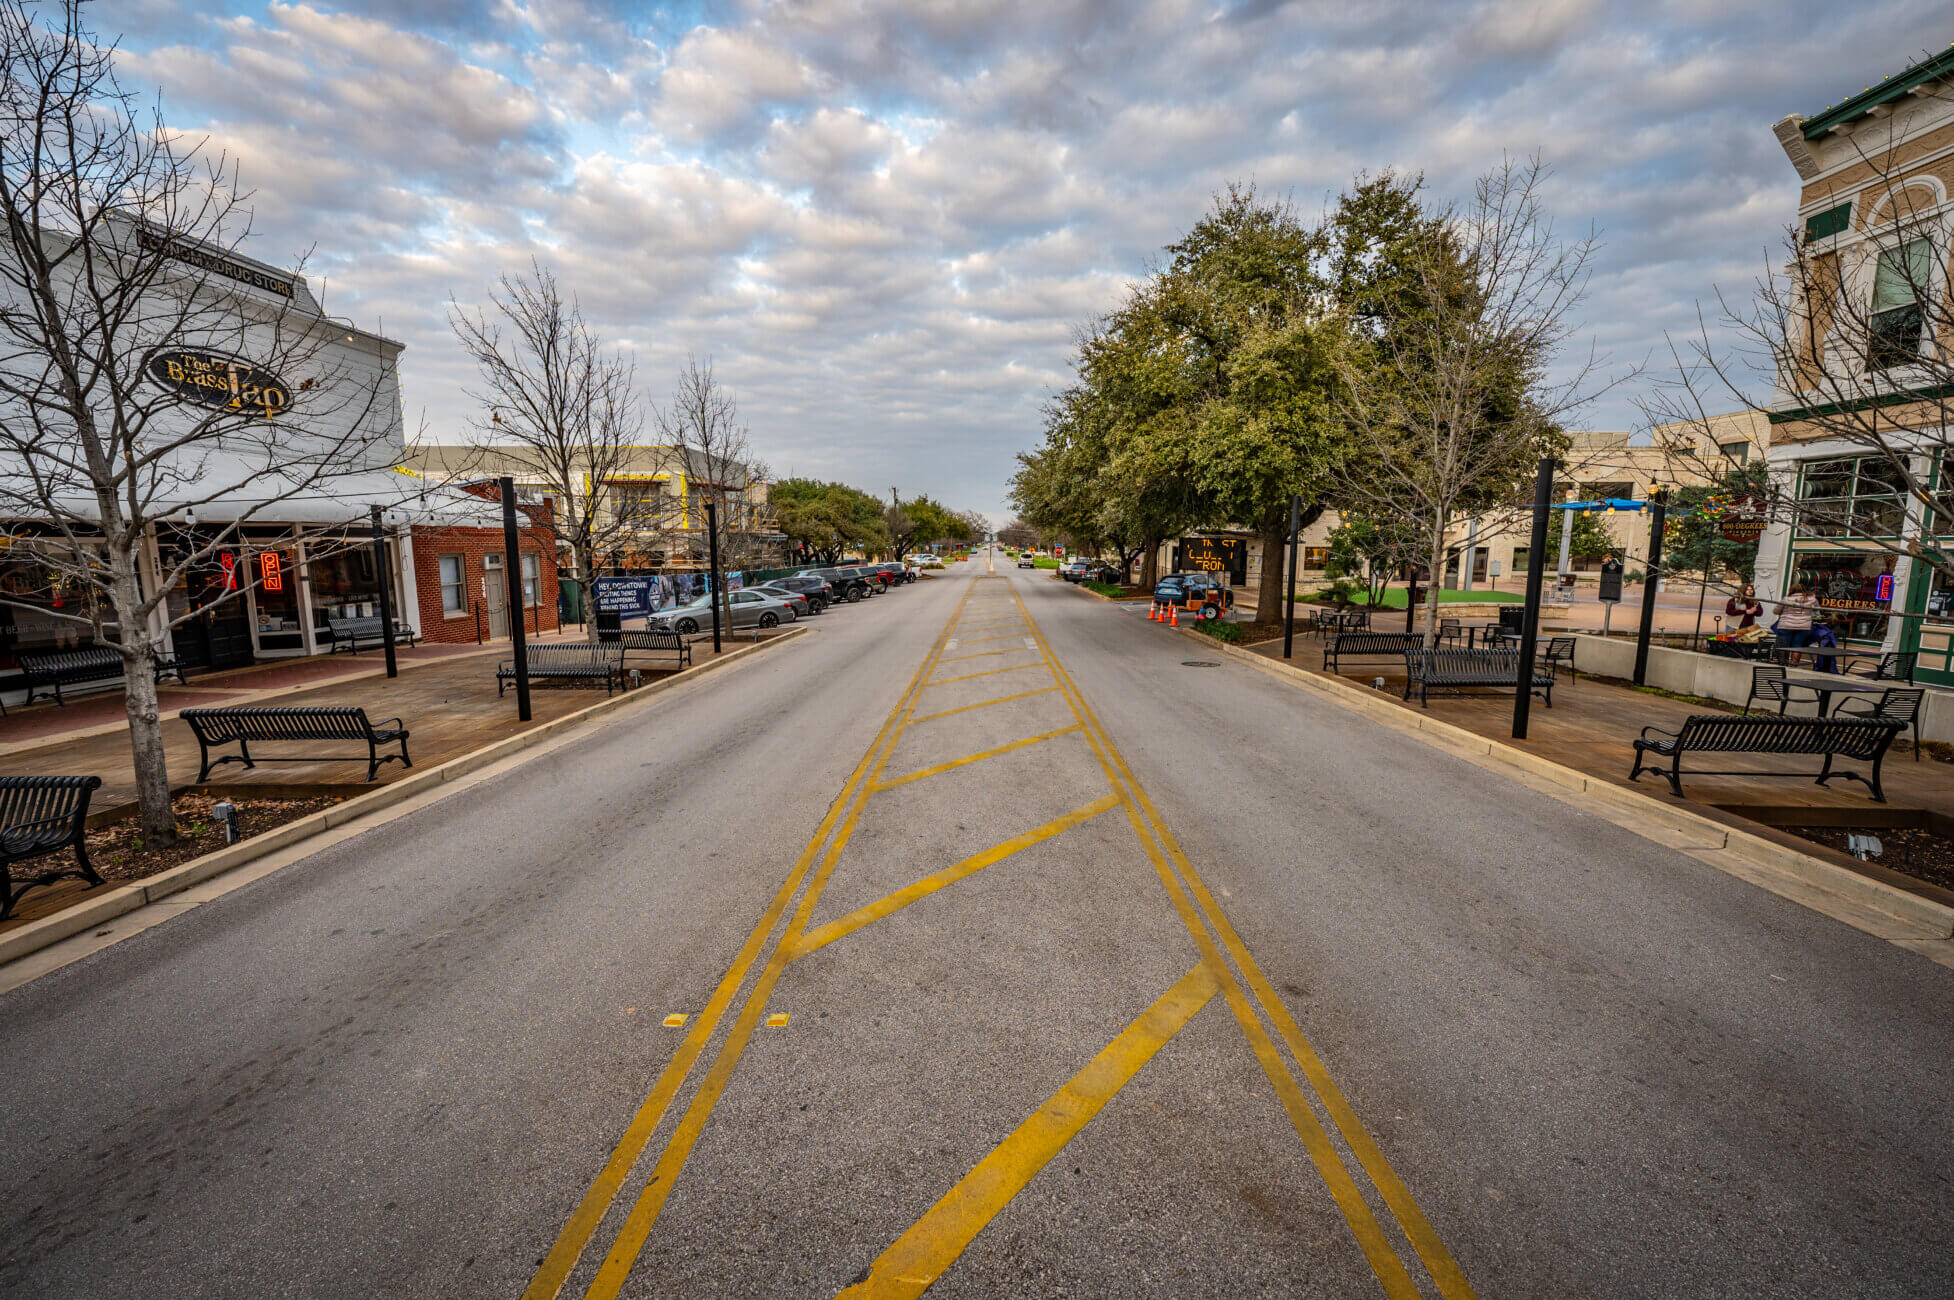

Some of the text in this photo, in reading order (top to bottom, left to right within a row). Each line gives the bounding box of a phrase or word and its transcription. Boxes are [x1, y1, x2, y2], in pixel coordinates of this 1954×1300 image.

[141, 232, 292, 296] NOMY DRUG STORE
[180, 354, 211, 372] The
[166, 358, 285, 420] Brass Tap
[1735, 522, 1769, 530] DEGREES
[264, 555, 278, 588] OPEN
[1880, 576, 1892, 600] OPEN
[1821, 598, 1876, 609] DEGREES
